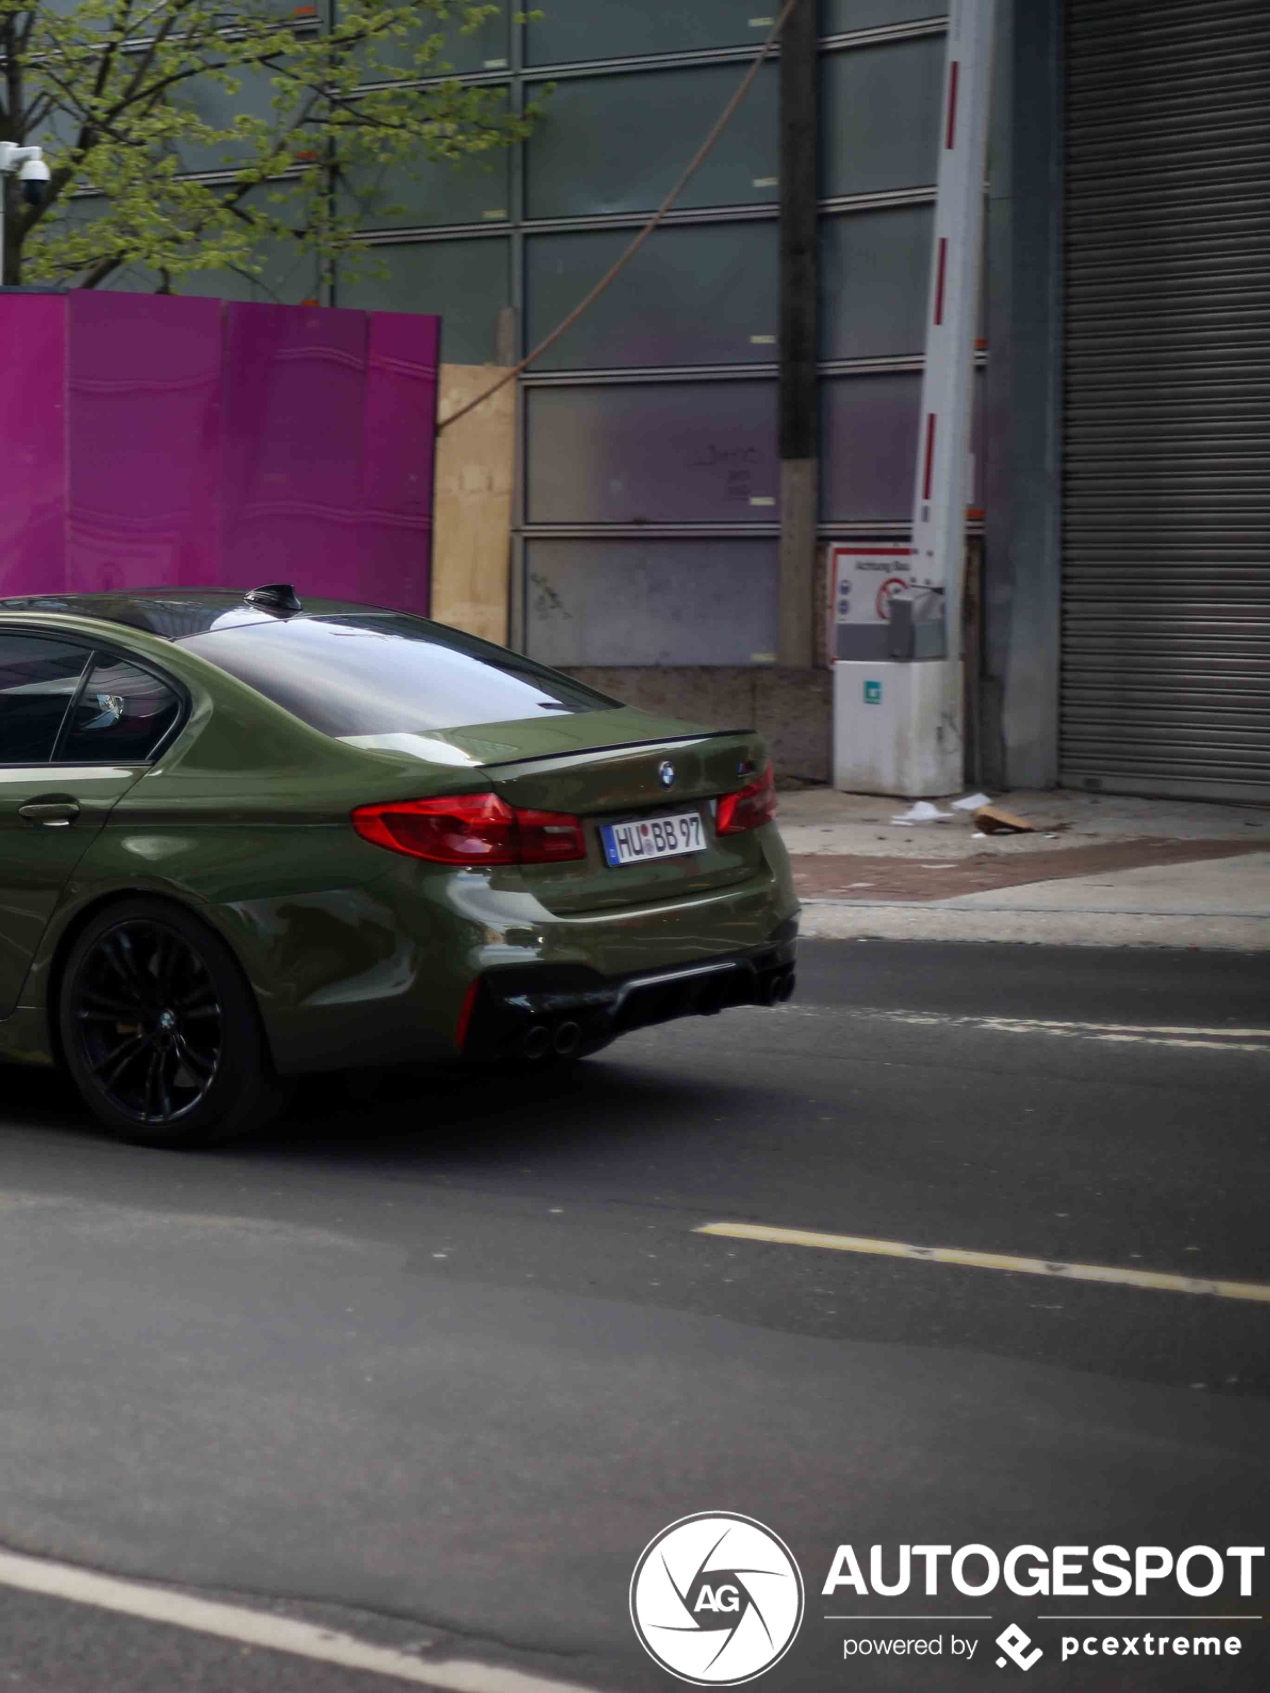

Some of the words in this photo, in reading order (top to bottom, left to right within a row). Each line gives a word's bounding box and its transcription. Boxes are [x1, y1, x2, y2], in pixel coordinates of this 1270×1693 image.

[615, 826, 644, 858] HU
[651, 821, 678, 852] BB
[679, 816, 700, 847] 97
